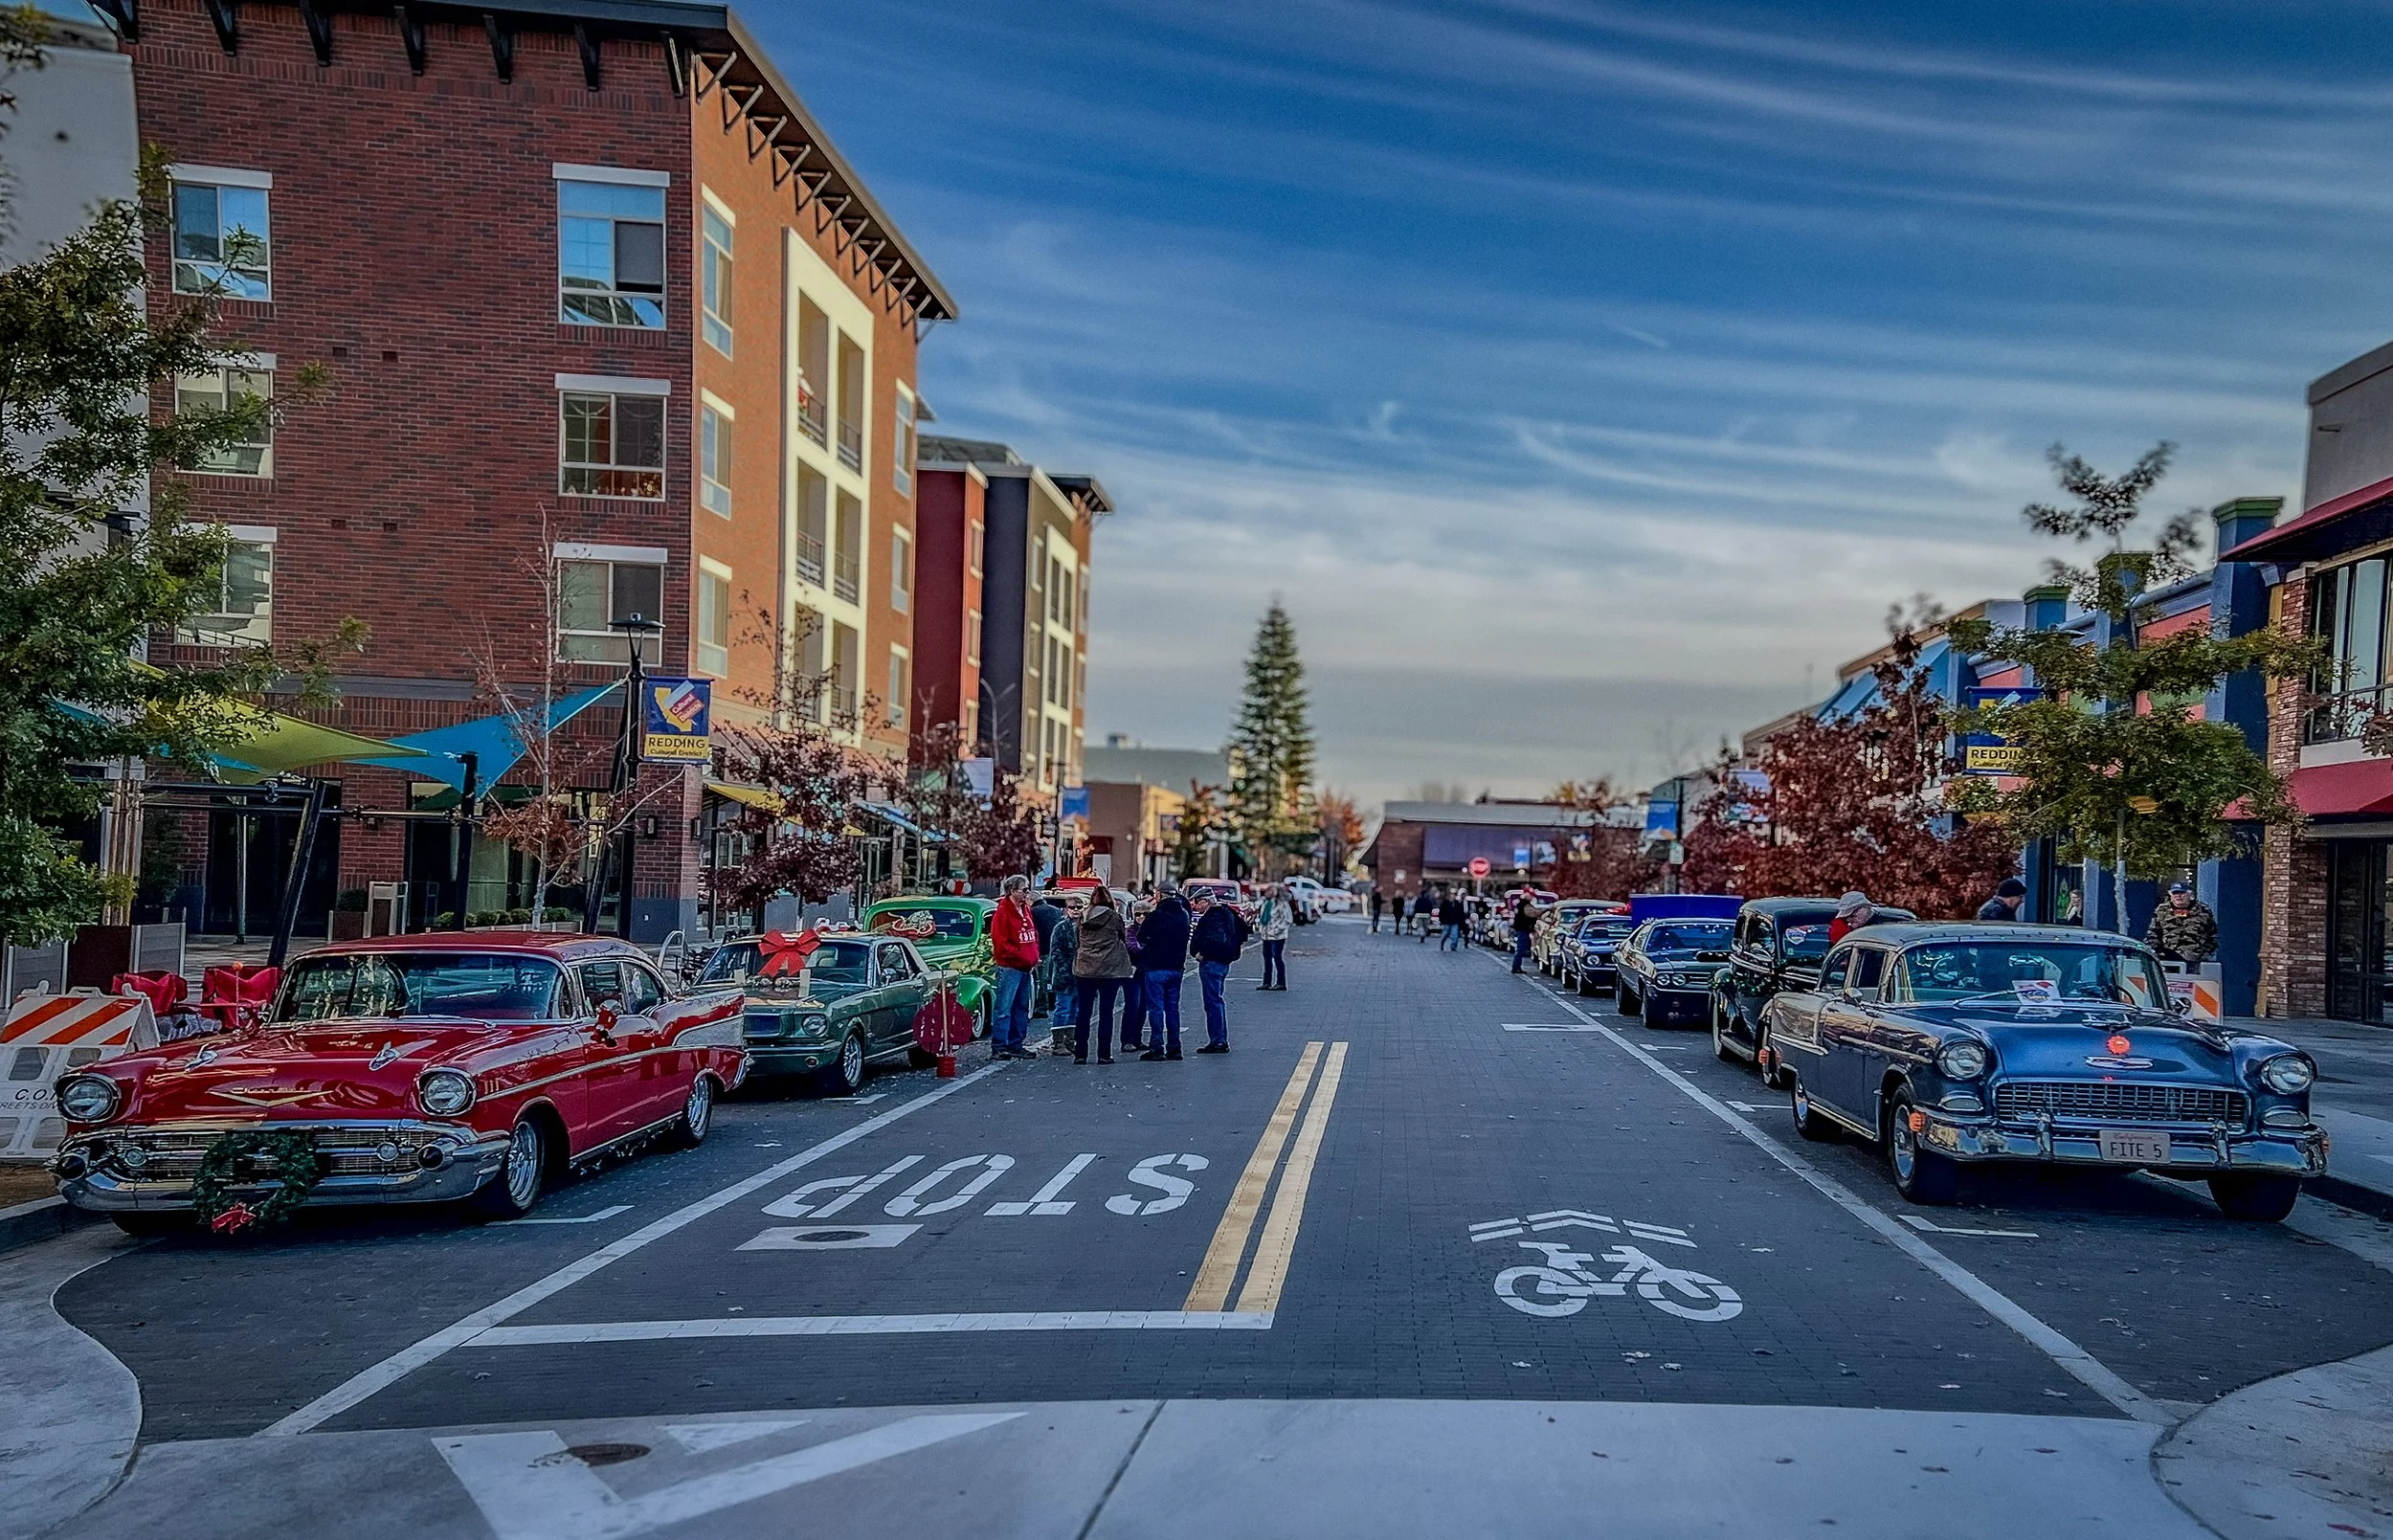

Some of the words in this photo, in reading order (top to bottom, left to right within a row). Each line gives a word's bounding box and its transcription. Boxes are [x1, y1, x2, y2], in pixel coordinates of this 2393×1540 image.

[648, 737, 705, 748] REDDING
[1971, 749, 2018, 760] REDDI
[0, 1102, 38, 1110] REETS
[2111, 1141, 2144, 1157] FITE
[2153, 1144, 2162, 1158] 5
[761, 1152, 1210, 1218] STOP
